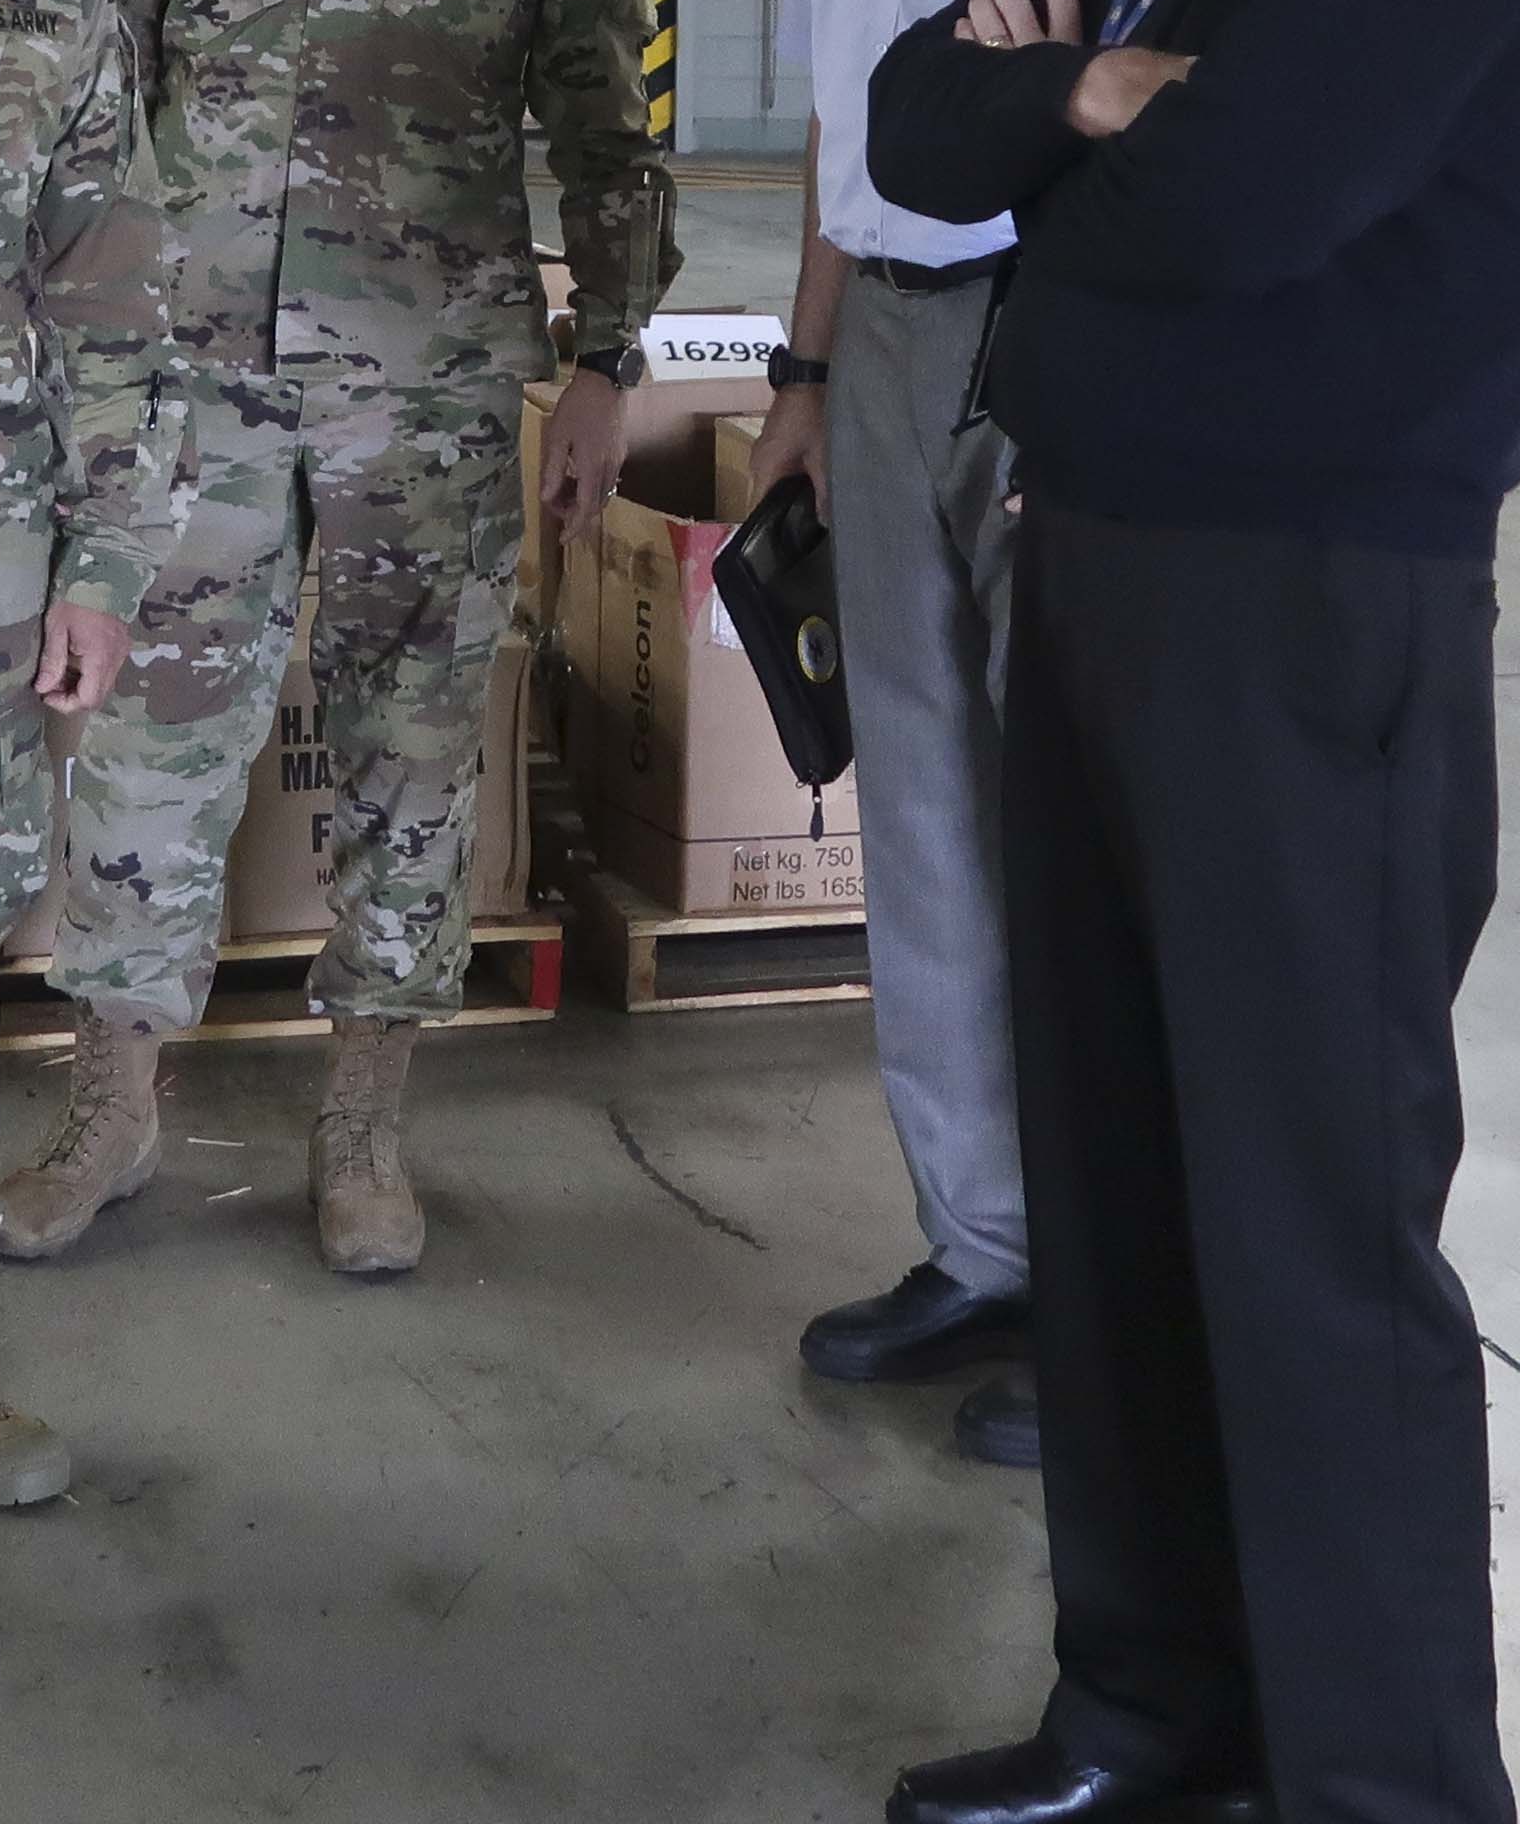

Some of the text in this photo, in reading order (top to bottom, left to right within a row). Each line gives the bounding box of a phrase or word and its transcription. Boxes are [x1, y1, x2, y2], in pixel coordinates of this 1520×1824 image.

[11, 8, 59, 36] ARMY
[661, 340, 772, 362] 16298
[631, 600, 652, 774] Celcon
[734, 846, 854, 874] Net kg. 750
[732, 881, 769, 902] Net
[776, 880, 806, 900] lbs
